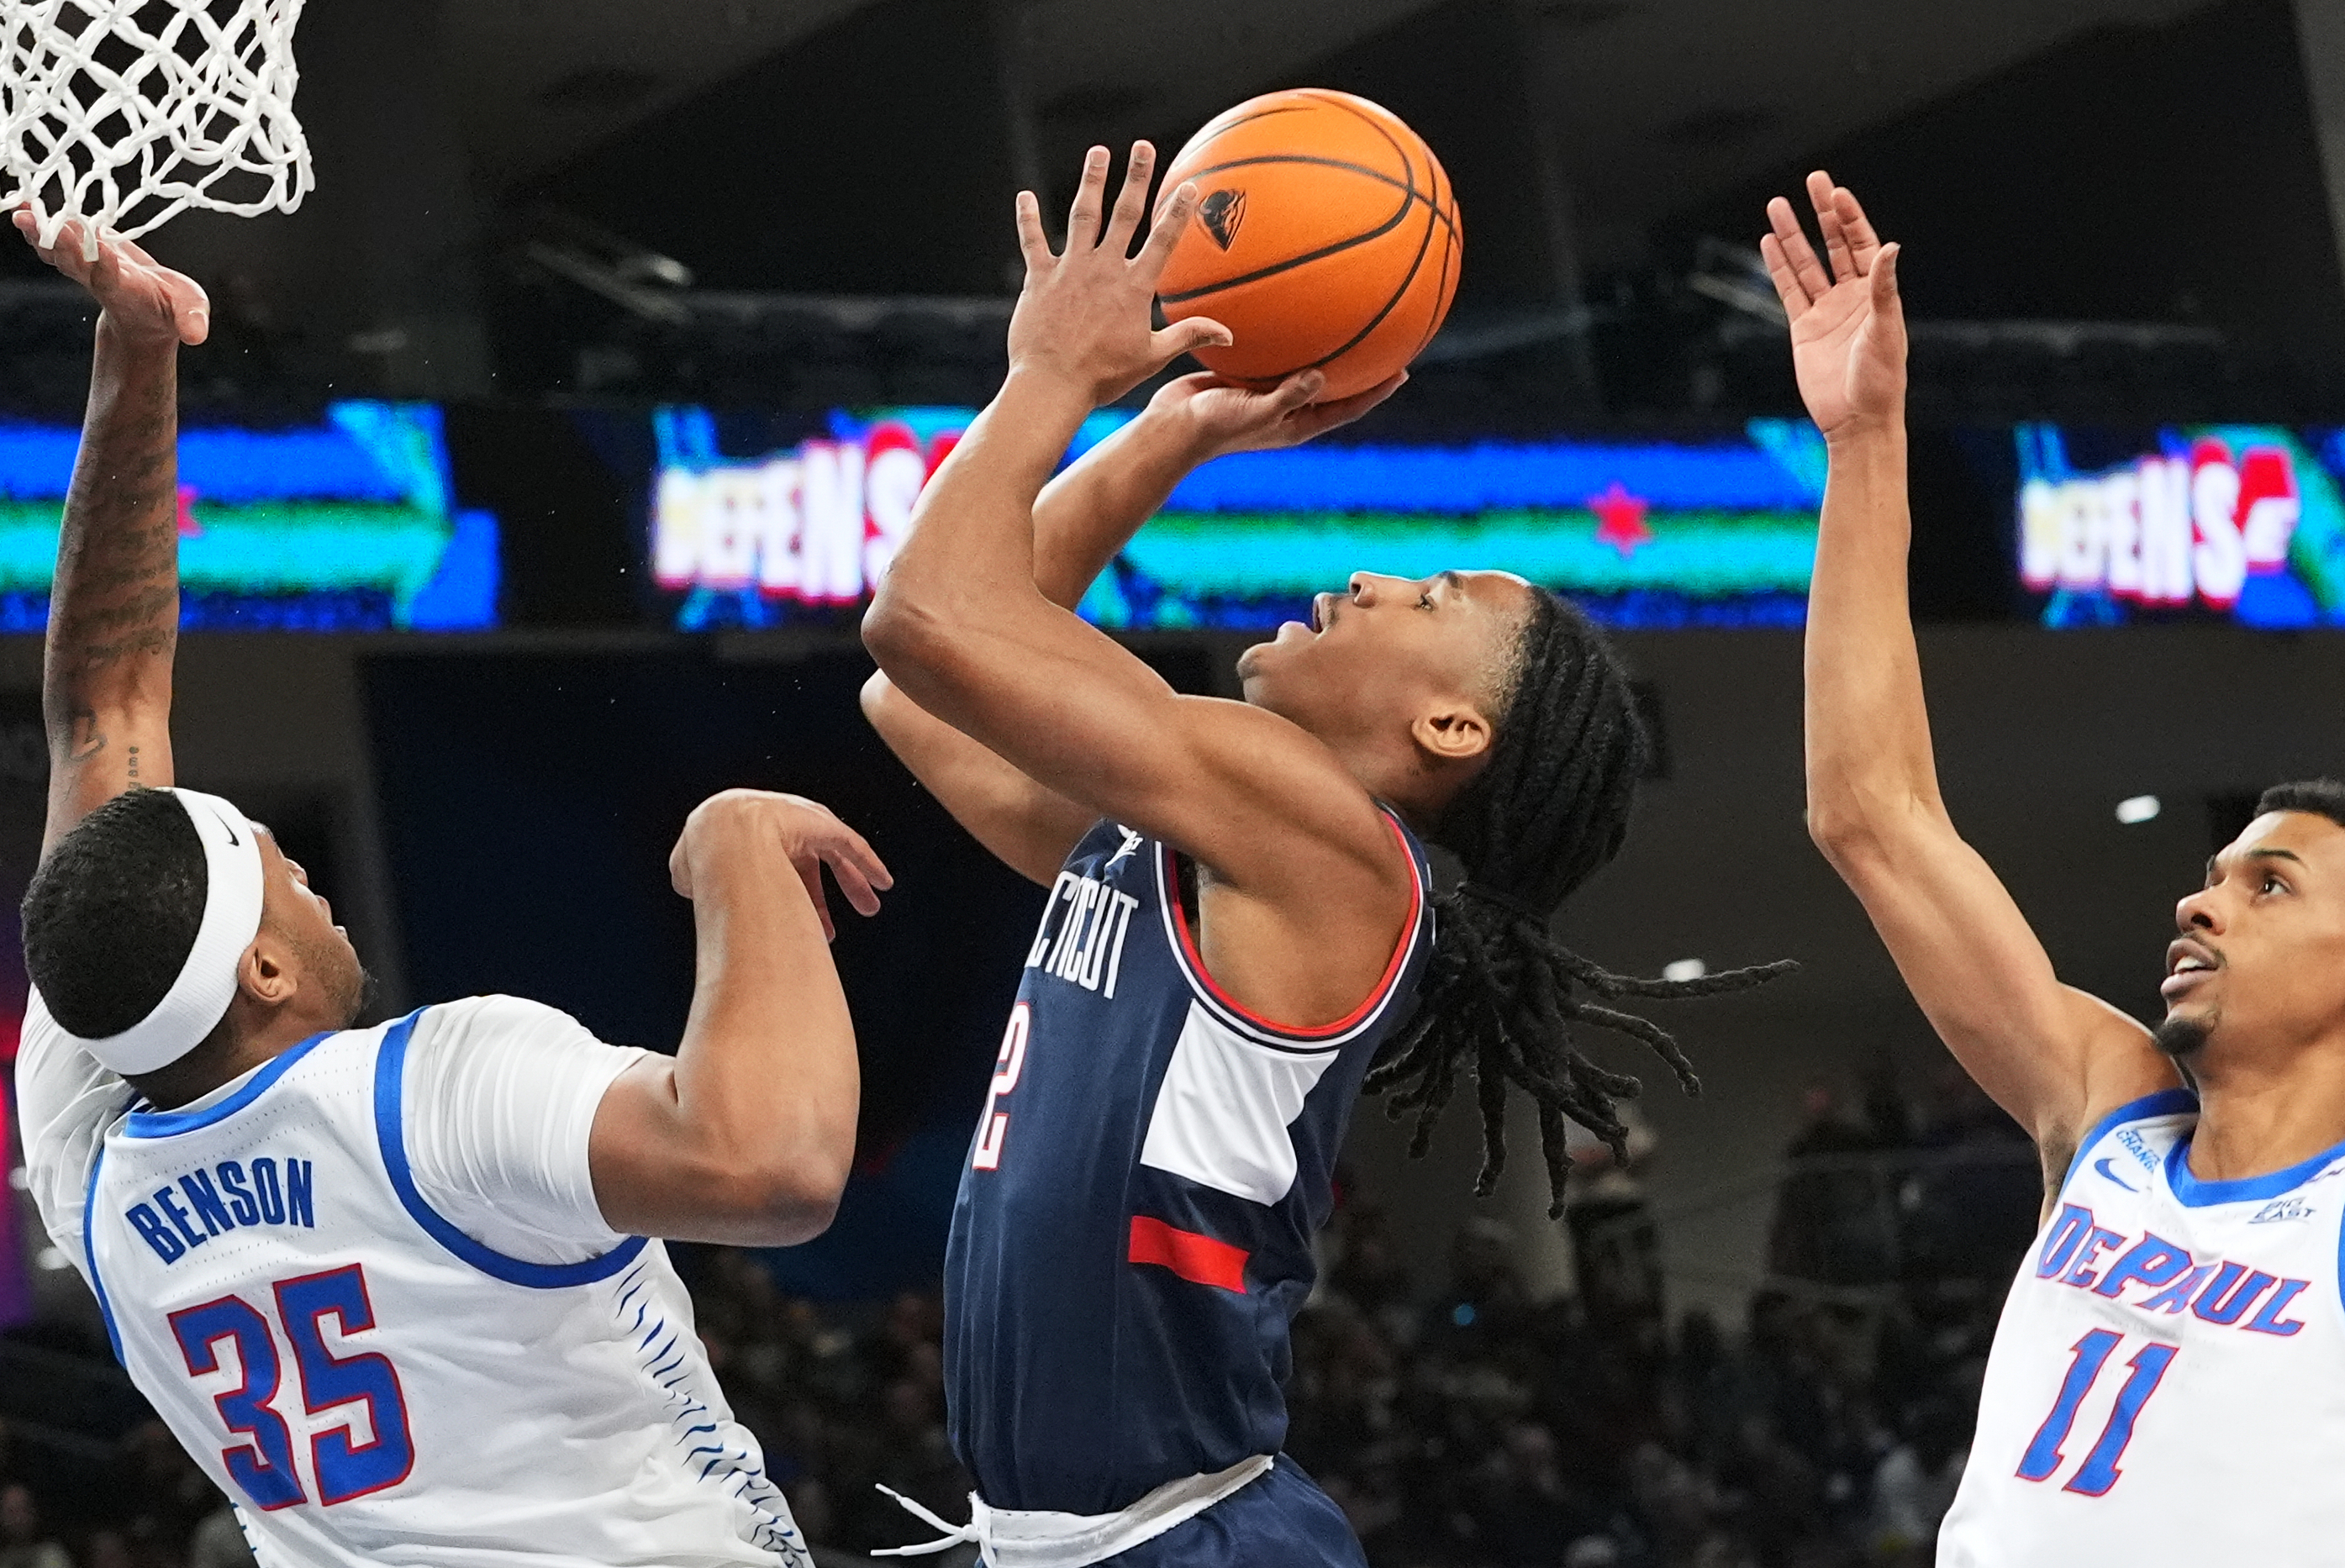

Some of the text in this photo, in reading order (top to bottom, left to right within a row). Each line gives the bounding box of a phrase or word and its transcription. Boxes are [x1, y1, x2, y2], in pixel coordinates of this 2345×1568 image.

[654, 422, 941, 605] DEFENS
[972, 1002, 1030, 1171] 2
[125, 1158, 314, 1265] BENSON
[167, 1263, 414, 1511] 35
[2015, 1328, 2180, 1497] 11
